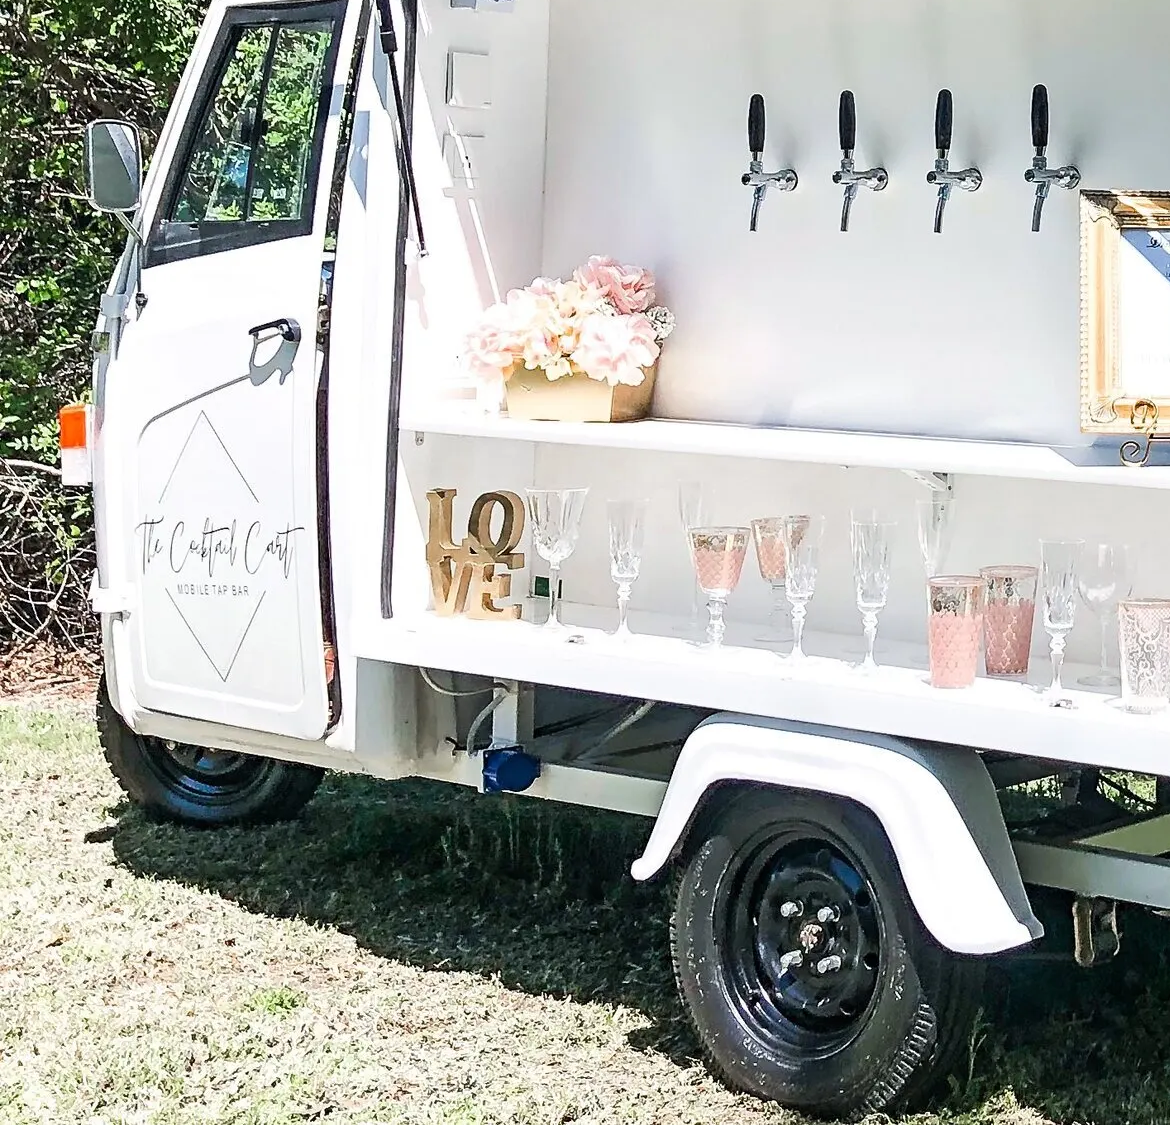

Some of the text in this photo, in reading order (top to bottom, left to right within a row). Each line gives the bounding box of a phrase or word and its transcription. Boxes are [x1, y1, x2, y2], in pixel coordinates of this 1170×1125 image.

[134, 514, 306, 580] The Cocktail Cart
[176, 583, 250, 597] MOBILE TAP BAR
